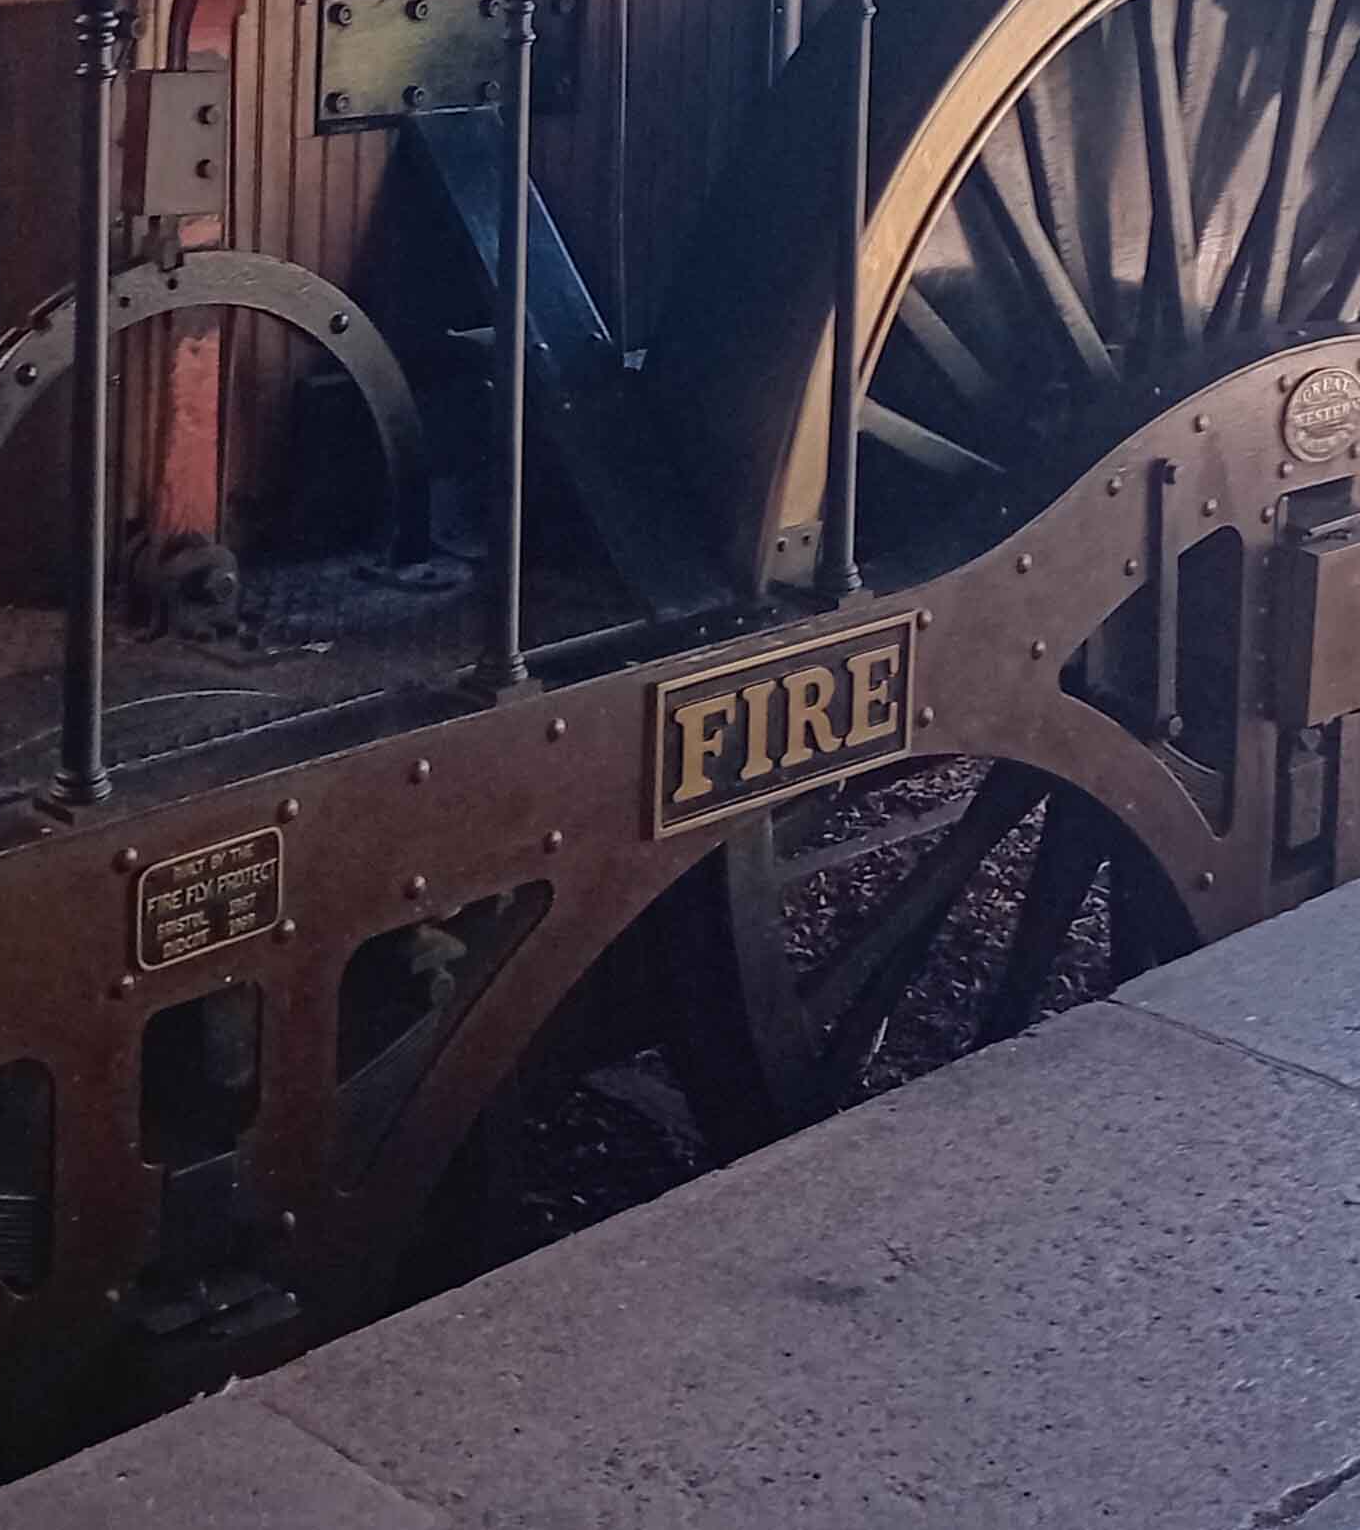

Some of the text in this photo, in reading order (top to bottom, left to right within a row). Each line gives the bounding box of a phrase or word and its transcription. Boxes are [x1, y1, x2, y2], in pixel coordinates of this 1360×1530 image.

[1301, 375, 1354, 403] GREAT
[673, 644, 901, 804] FIRE
[229, 843, 256, 863] THE
[146, 888, 184, 917] FIRE
[185, 877, 215, 906] FLY
